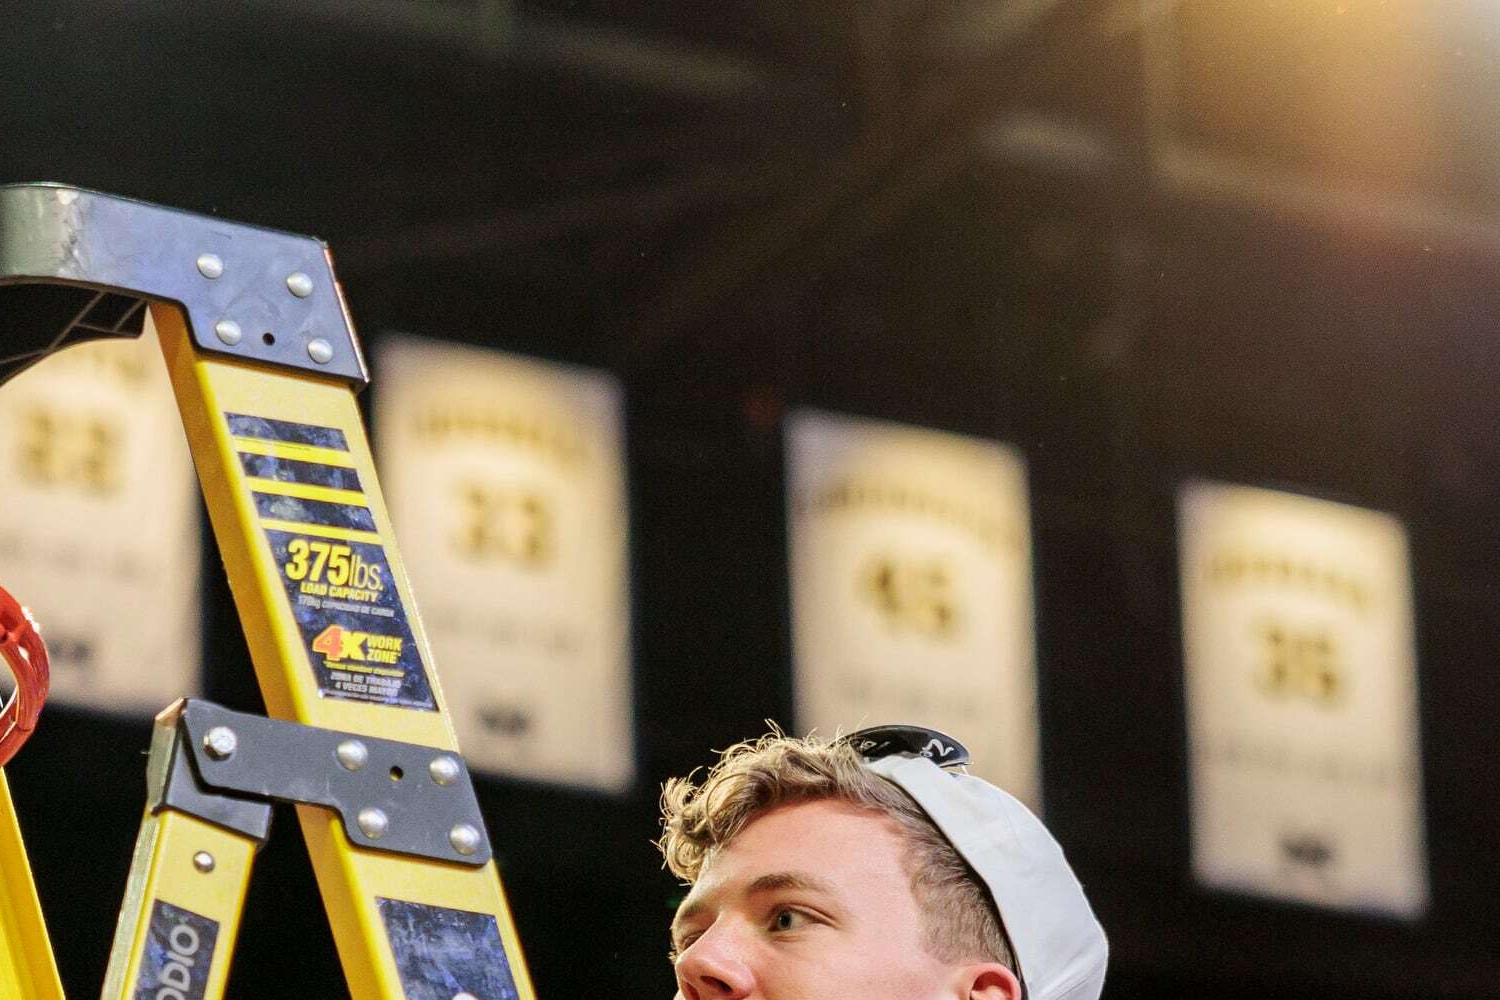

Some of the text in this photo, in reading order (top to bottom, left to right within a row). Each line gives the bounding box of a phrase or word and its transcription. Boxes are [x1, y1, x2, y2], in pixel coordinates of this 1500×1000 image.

[301, 582, 379, 602] LOAD CAPACITY
[366, 635, 403, 651] WORK
